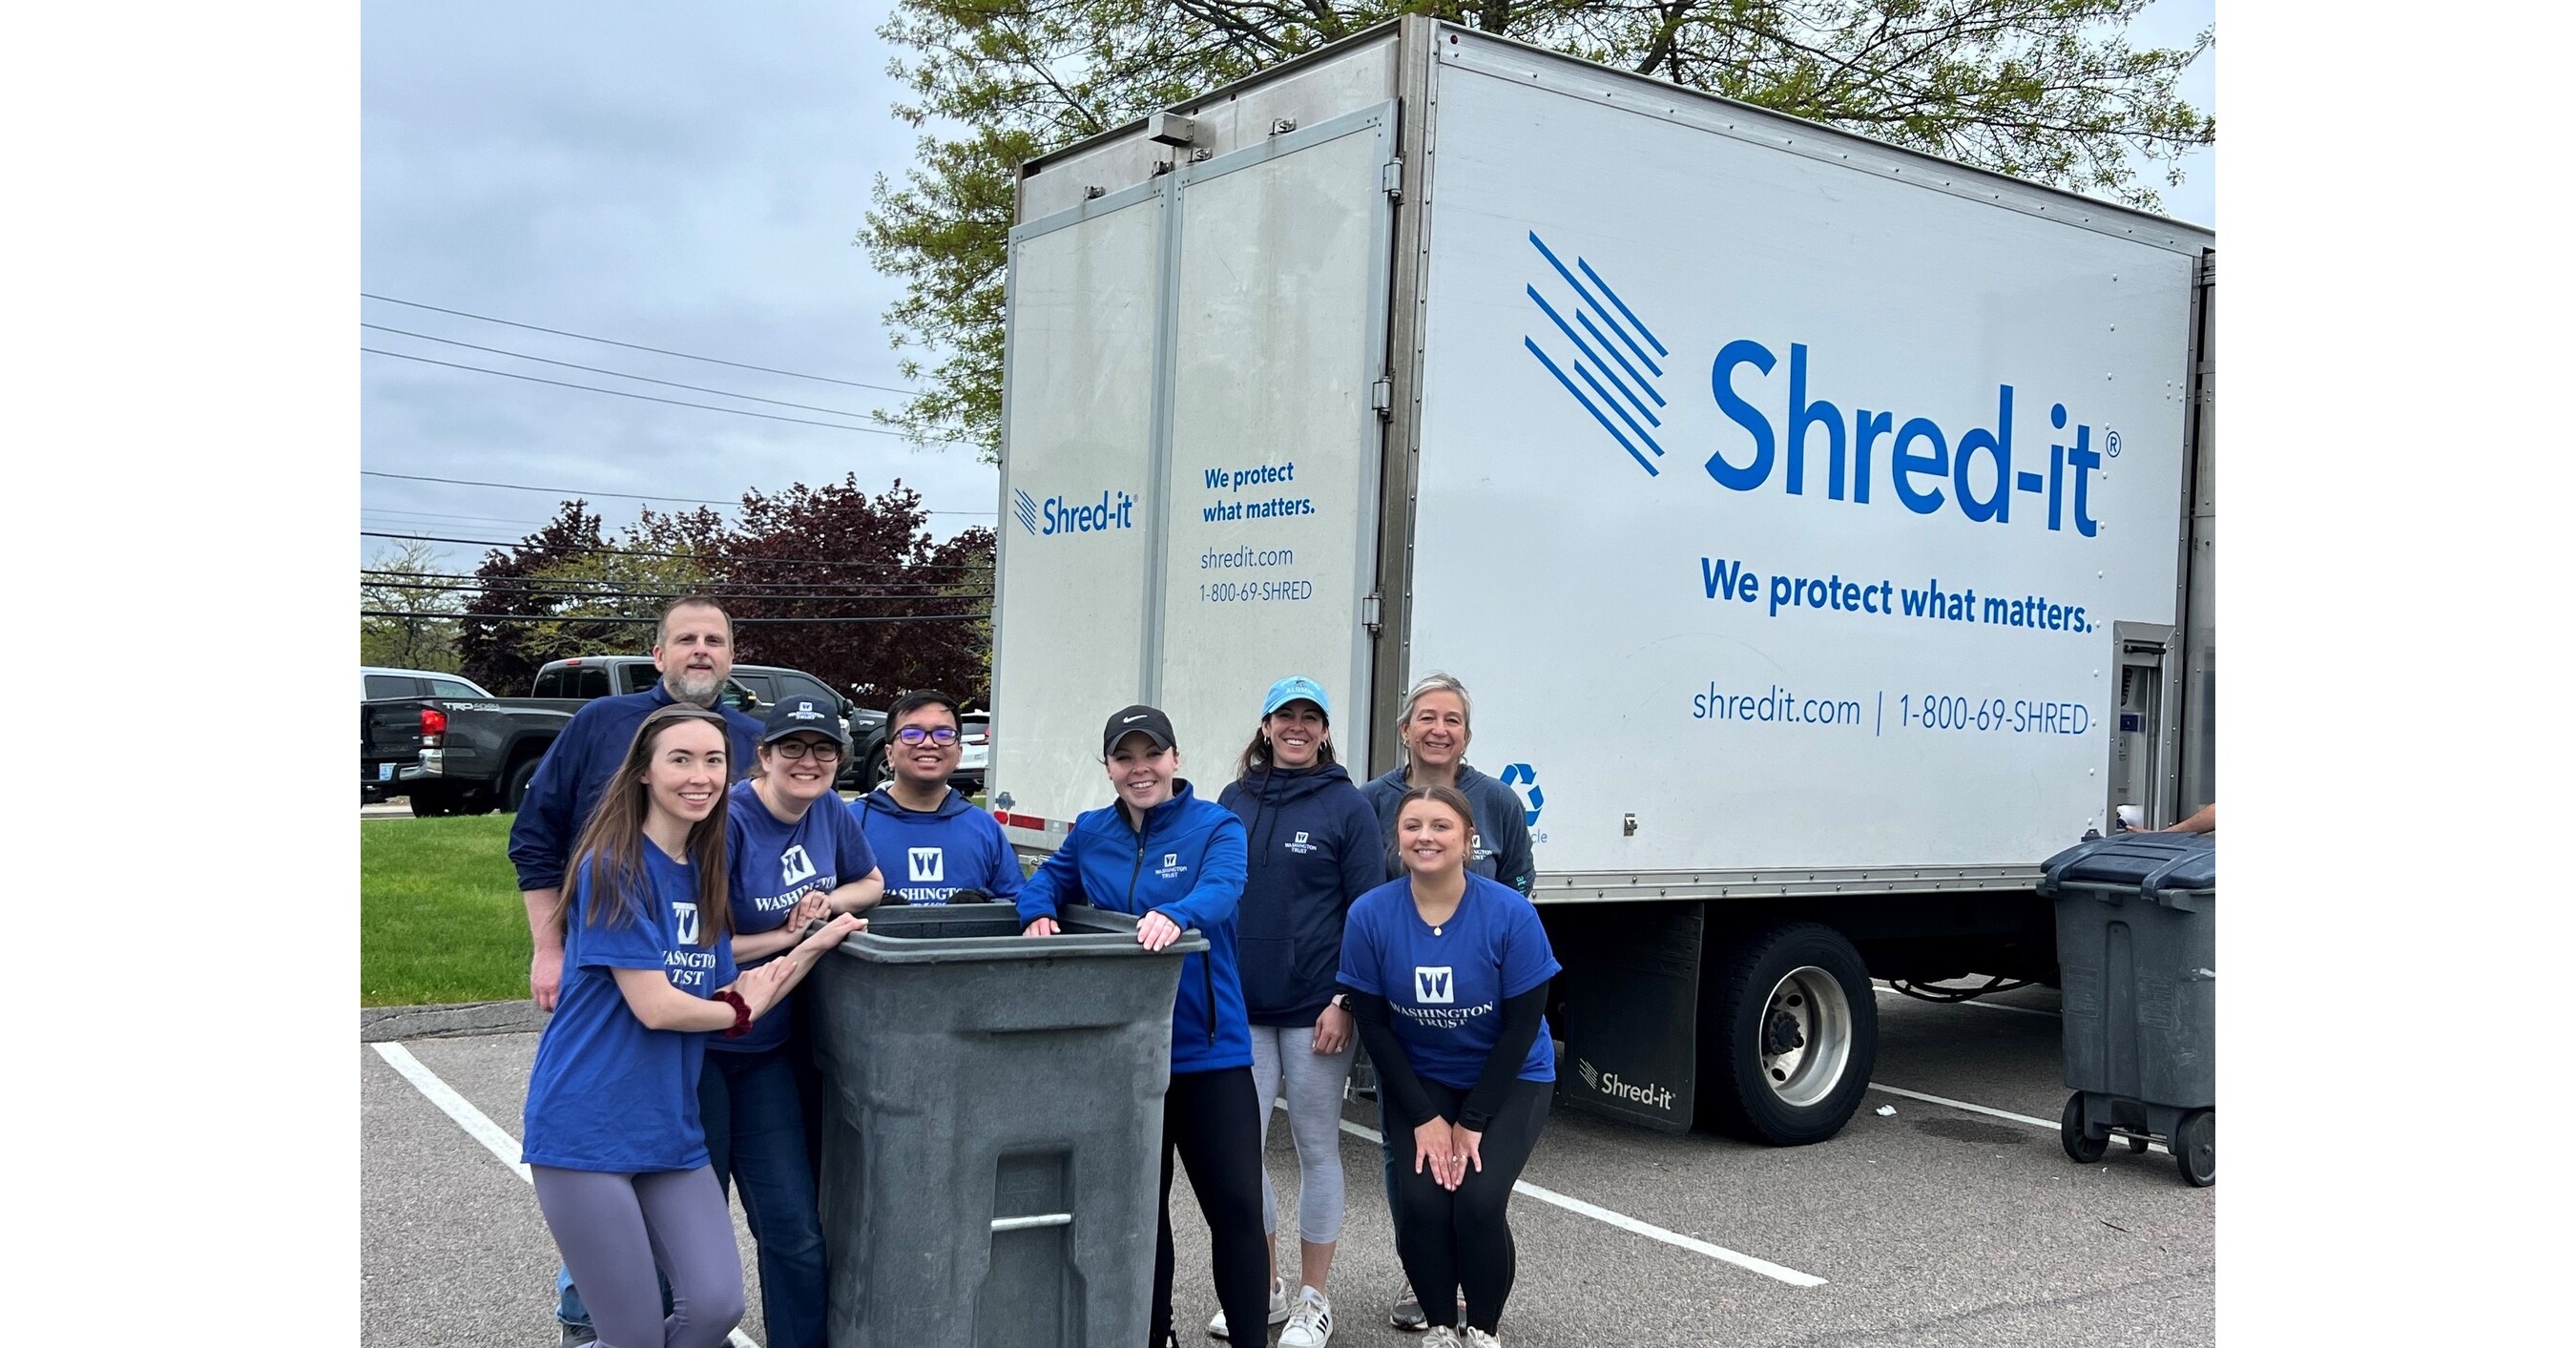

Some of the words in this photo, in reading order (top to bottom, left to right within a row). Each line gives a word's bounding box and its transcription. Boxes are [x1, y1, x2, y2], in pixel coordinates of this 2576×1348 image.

[1204, 467, 1230, 489] We
[1233, 462, 1294, 493] protect
[1203, 500, 1242, 523] what
[1246, 497, 1316, 519] matters.
[1200, 545, 1293, 570] shredit.com
[1199, 580, 1313, 603] 1-800-69-SHRED
[1700, 557, 1759, 603] We
[1769, 574, 1894, 617] protect
[1901, 578, 1976, 623] what
[1984, 595, 2092, 633] matters.
[1693, 680, 1860, 725] shredit.com
[1901, 694, 2088, 735] 1-800-69-SHRED
[1417, 971, 1451, 999] W
[1389, 1000, 1493, 1019] WASHINGTON
[1415, 1017, 1467, 1028] TRUST
